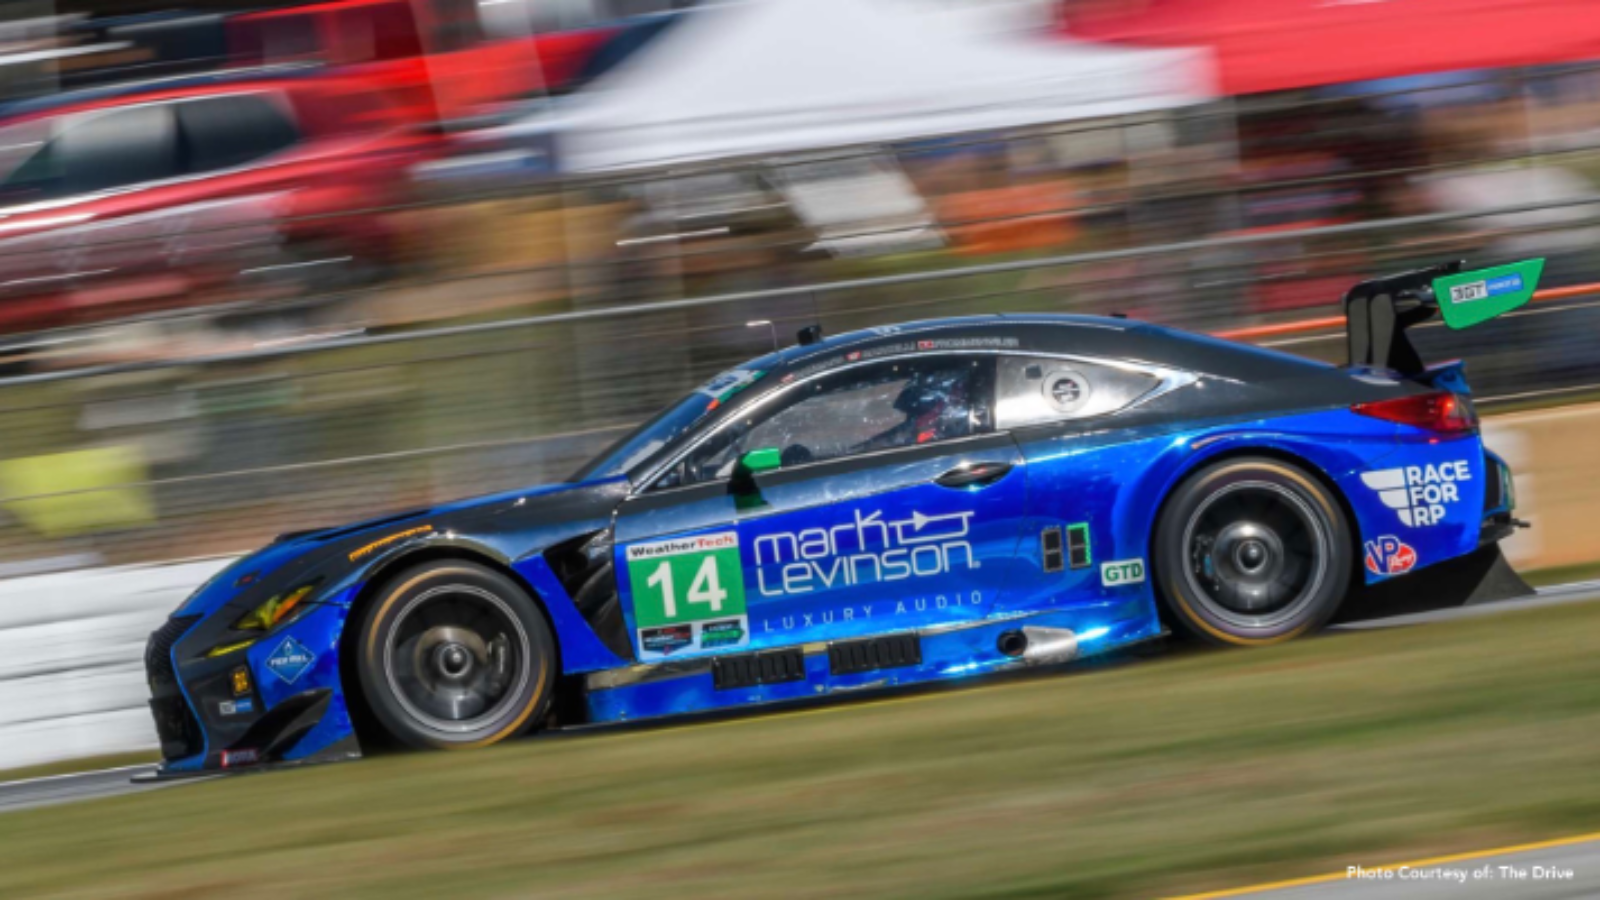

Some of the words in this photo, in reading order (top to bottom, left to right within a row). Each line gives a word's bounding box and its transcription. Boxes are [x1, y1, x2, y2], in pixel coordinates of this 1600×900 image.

[1406, 460, 1472, 486] RACE
[1410, 482, 1460, 506] FOR
[1413, 504, 1446, 527] RP
[630, 535, 734, 557] WeatherTech
[1104, 562, 1143, 582] GTD
[646, 555, 728, 618] 14
[763, 605, 873, 632] LUXURY
[895, 590, 982, 615] AUDIO
